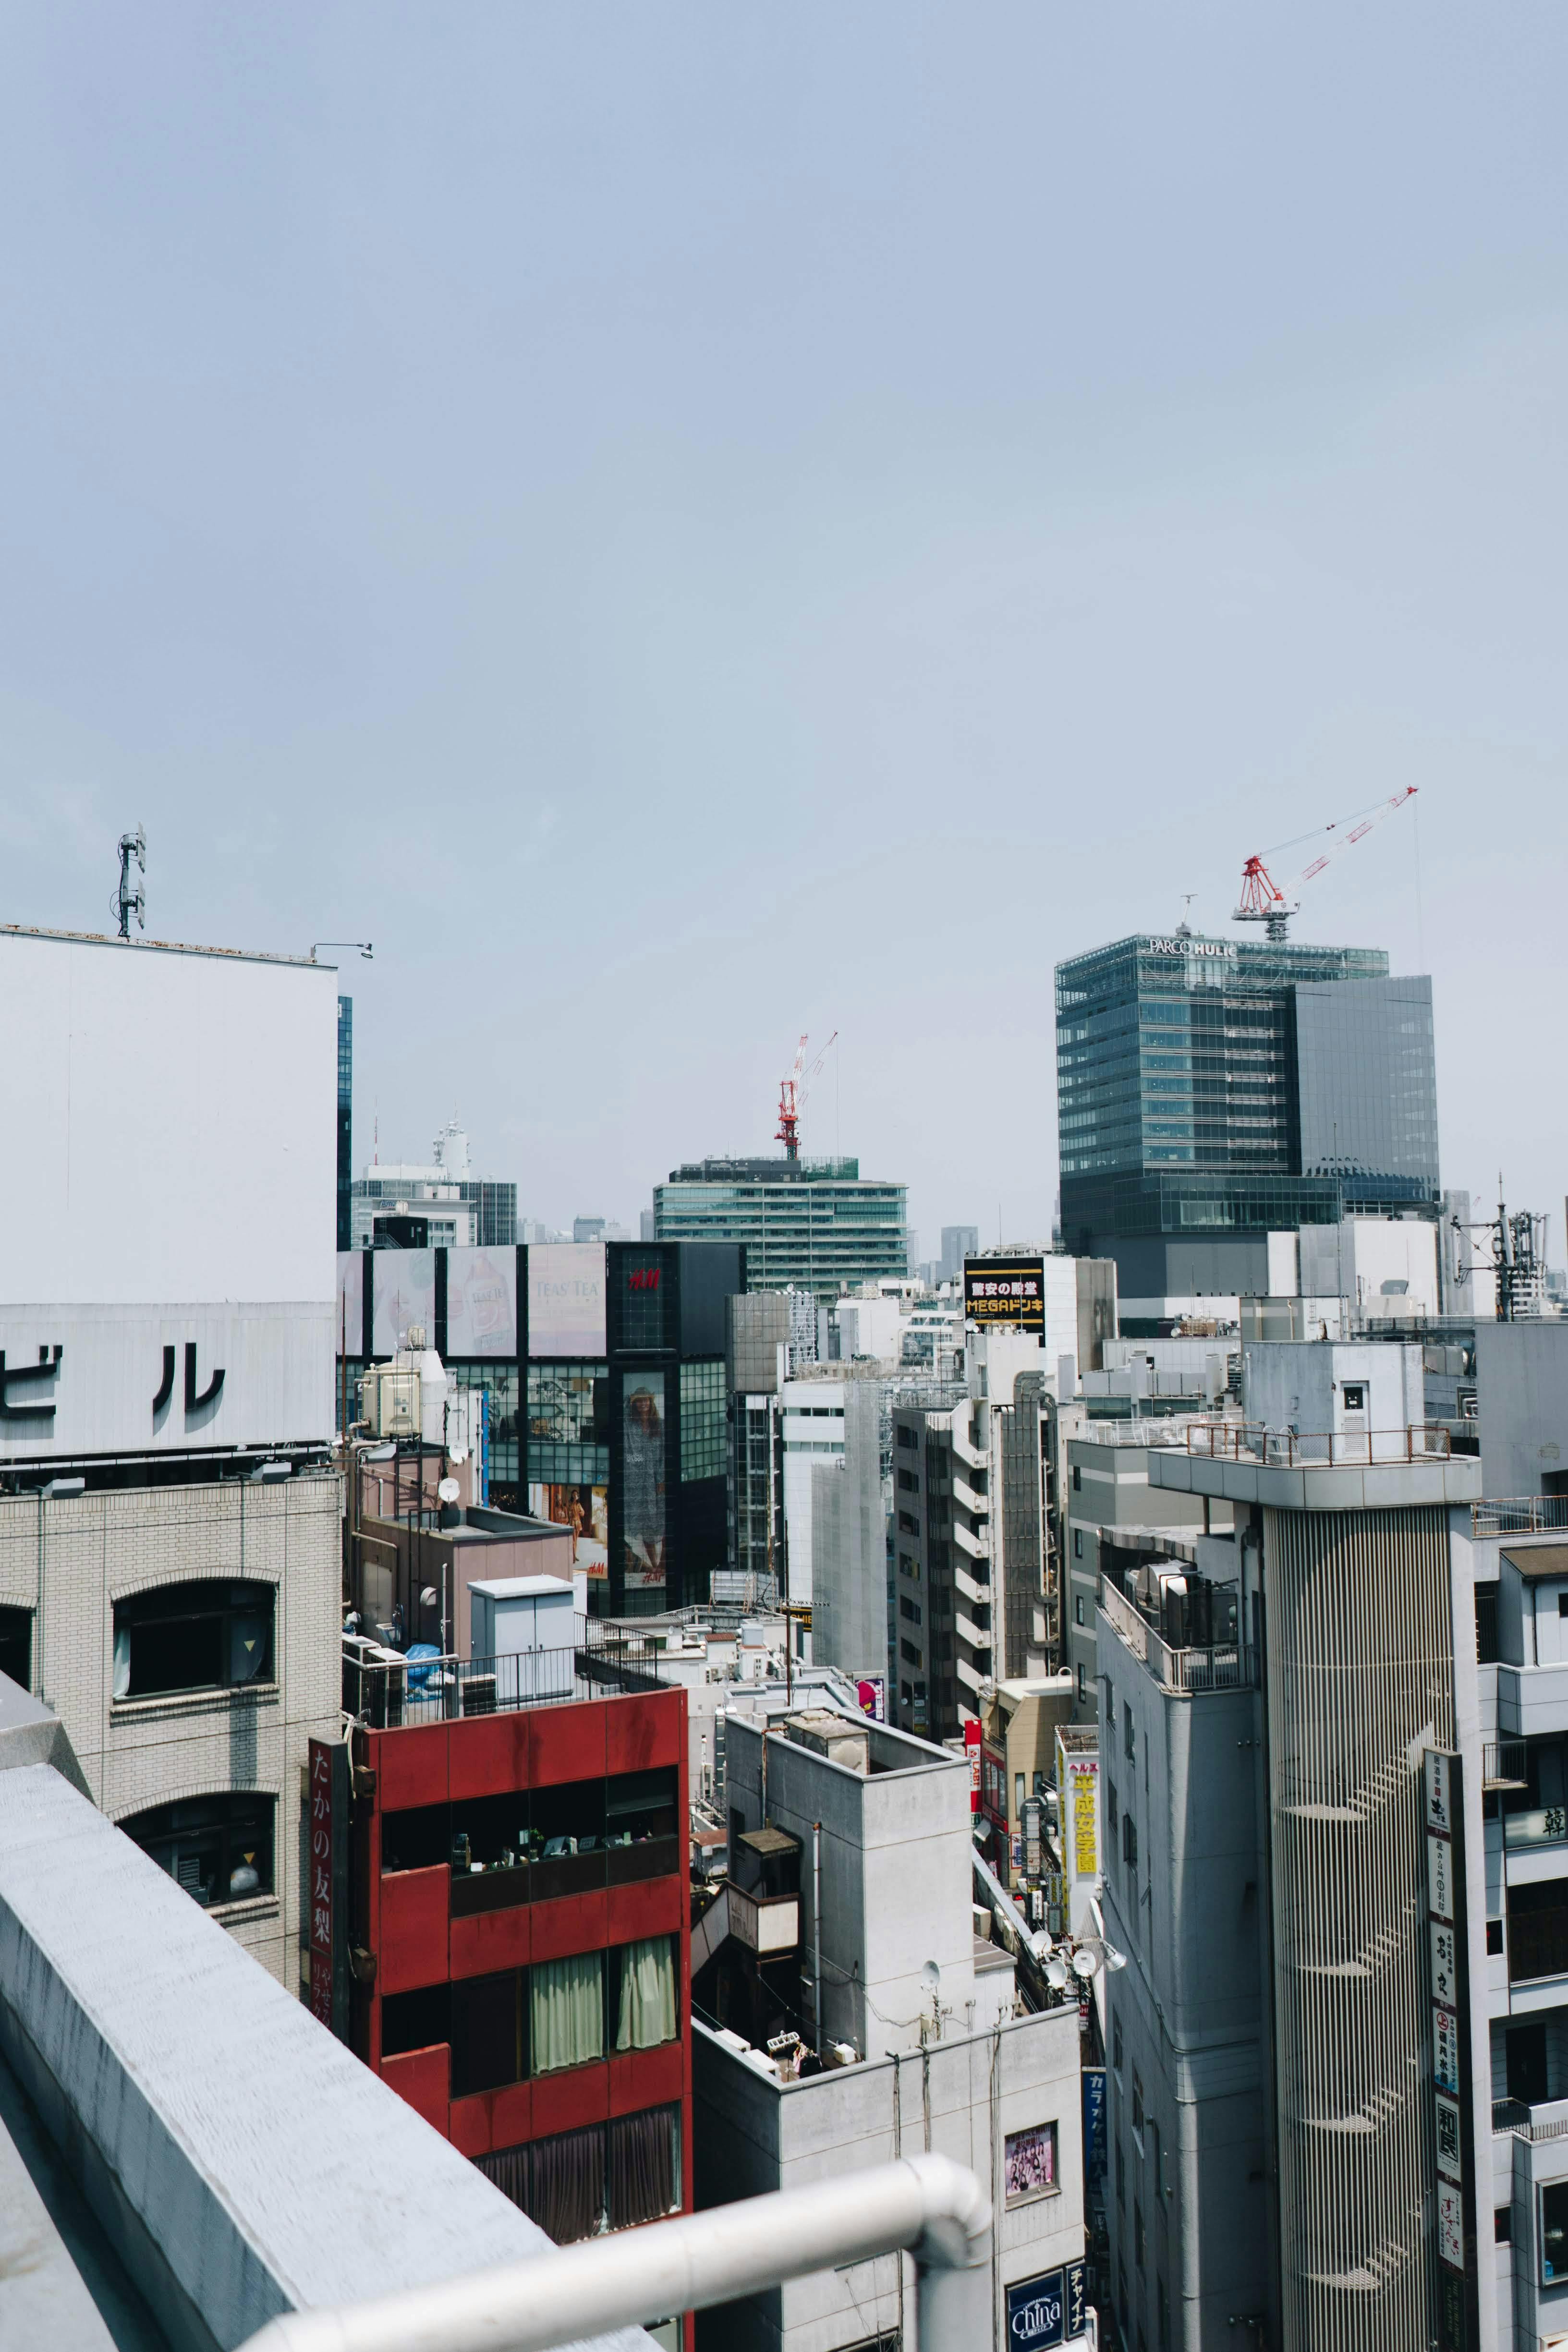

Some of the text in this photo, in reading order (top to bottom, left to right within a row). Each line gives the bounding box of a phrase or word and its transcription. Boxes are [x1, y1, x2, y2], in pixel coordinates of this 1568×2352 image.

[1150, 939, 1237, 957] PARCO HULIC
[629, 1267, 660, 1290] H&M
[972, 1282, 1037, 1296] 驚安の殿堂
[967, 1299, 1043, 1312] MEGAドンキ
[0, 1343, 226, 1415] ビル
[588, 1562, 604, 1575] H&M
[1070, 1763, 1098, 1772] ヘルス
[1073, 1775, 1097, 1873] 平成女学園
[314, 1748, 330, 1944] たかの友梨
[1439, 2107, 1456, 2158] 和民
[1071, 2268, 1083, 2330] チャイナ
[1012, 2302, 1060, 2334] China
